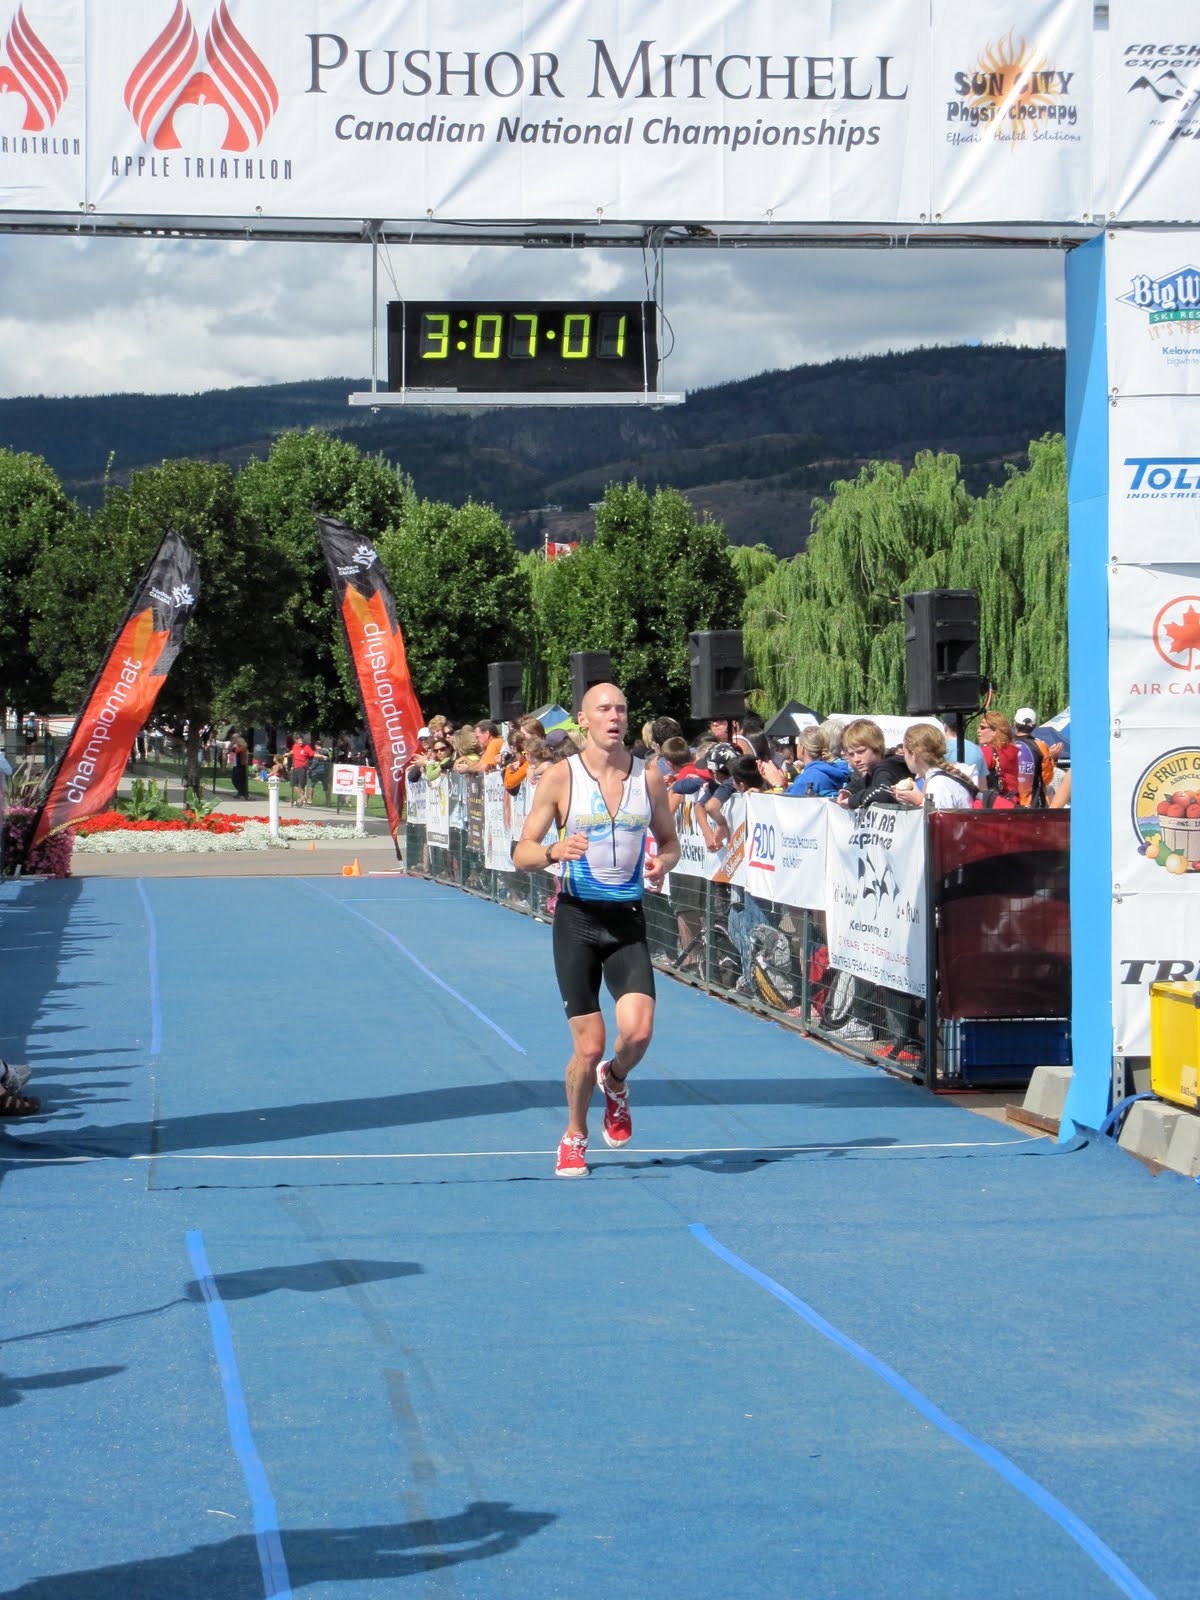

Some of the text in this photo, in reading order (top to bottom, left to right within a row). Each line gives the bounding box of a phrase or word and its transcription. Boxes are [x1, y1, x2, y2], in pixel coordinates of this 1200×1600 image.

[304, 33, 909, 100] PUSHOR MITCHELL
[953, 71, 1005, 97] SUN
[945, 99, 1078, 128] Physitherapy
[334, 113, 881, 152] Canadian National Championships
[993, 130, 1028, 142] Health
[1033, 130, 1081, 142] Solutions
[111, 155, 292, 180] APPLE TRIATHLON
[1153, 312, 1173, 322] SKI
[1123, 457, 1200, 490] TOL
[361, 622, 407, 783] championship
[1129, 682, 1200, 695] AIR CA
[67, 657, 142, 804] championnat
[1142, 782, 1159, 801] BC
[1153, 757, 1189, 784] FRUIT
[1119, 959, 1200, 984] TR
